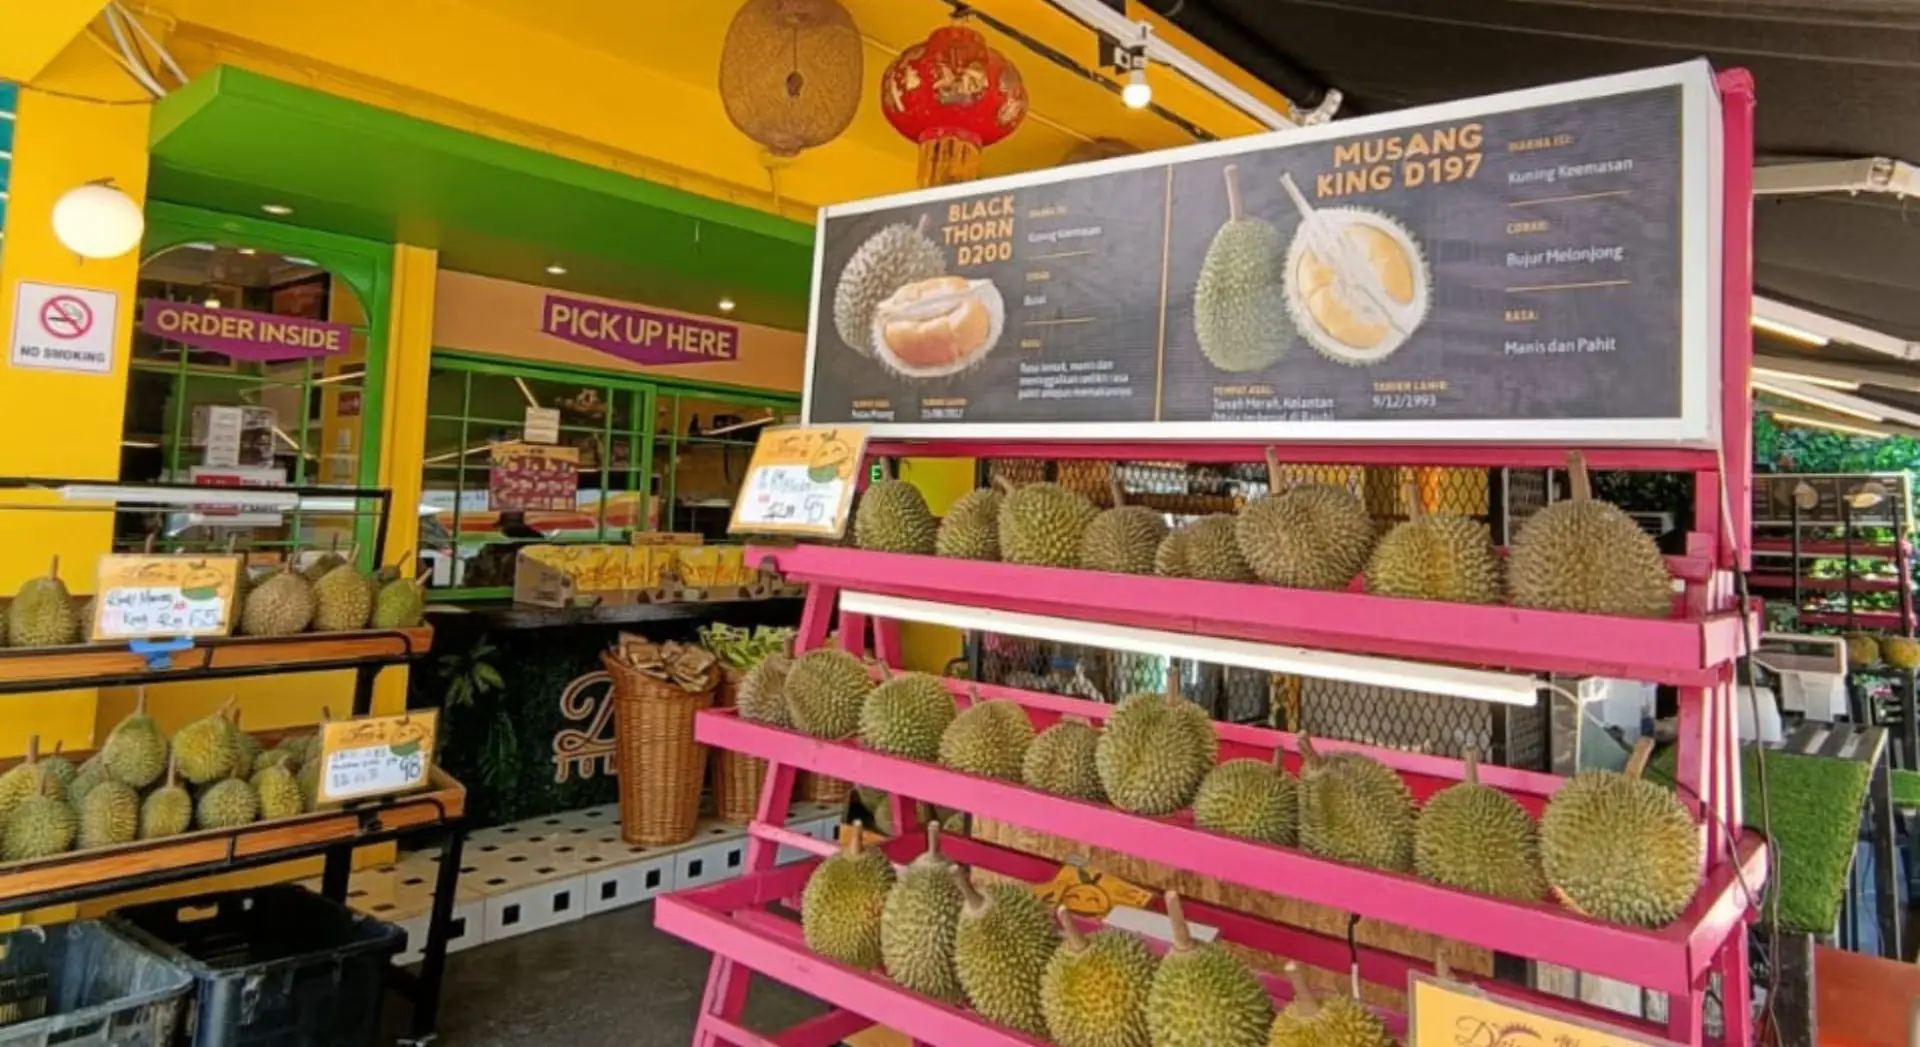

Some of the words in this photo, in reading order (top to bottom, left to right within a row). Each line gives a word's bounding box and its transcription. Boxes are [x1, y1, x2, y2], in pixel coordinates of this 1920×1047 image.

[1333, 123, 1483, 168] MUSANG
[1316, 165, 1392, 198] KING
[1404, 152, 1483, 187] D197
[1508, 167, 1556, 184] Kuning
[1558, 159, 1633, 178] Keemasan
[948, 195, 1015, 222] BLACK
[942, 217, 1014, 246] THORN
[958, 241, 1012, 266] D200
[1506, 250, 1543, 269] Bujur
[1546, 246, 1624, 264] Melonjong
[156, 308, 254, 342] ORDER
[259, 321, 341, 351] INSIDE
[550, 303, 623, 341] PICK
[625, 316, 664, 346] UP
[666, 327, 732, 357] HERE
[20, 345, 40, 357] NO
[43, 347, 105, 363] SMOKING
[1505, 340, 1545, 355] Manis
[1547, 338, 1575, 353] dan
[1577, 336, 1617, 352] Pahit
